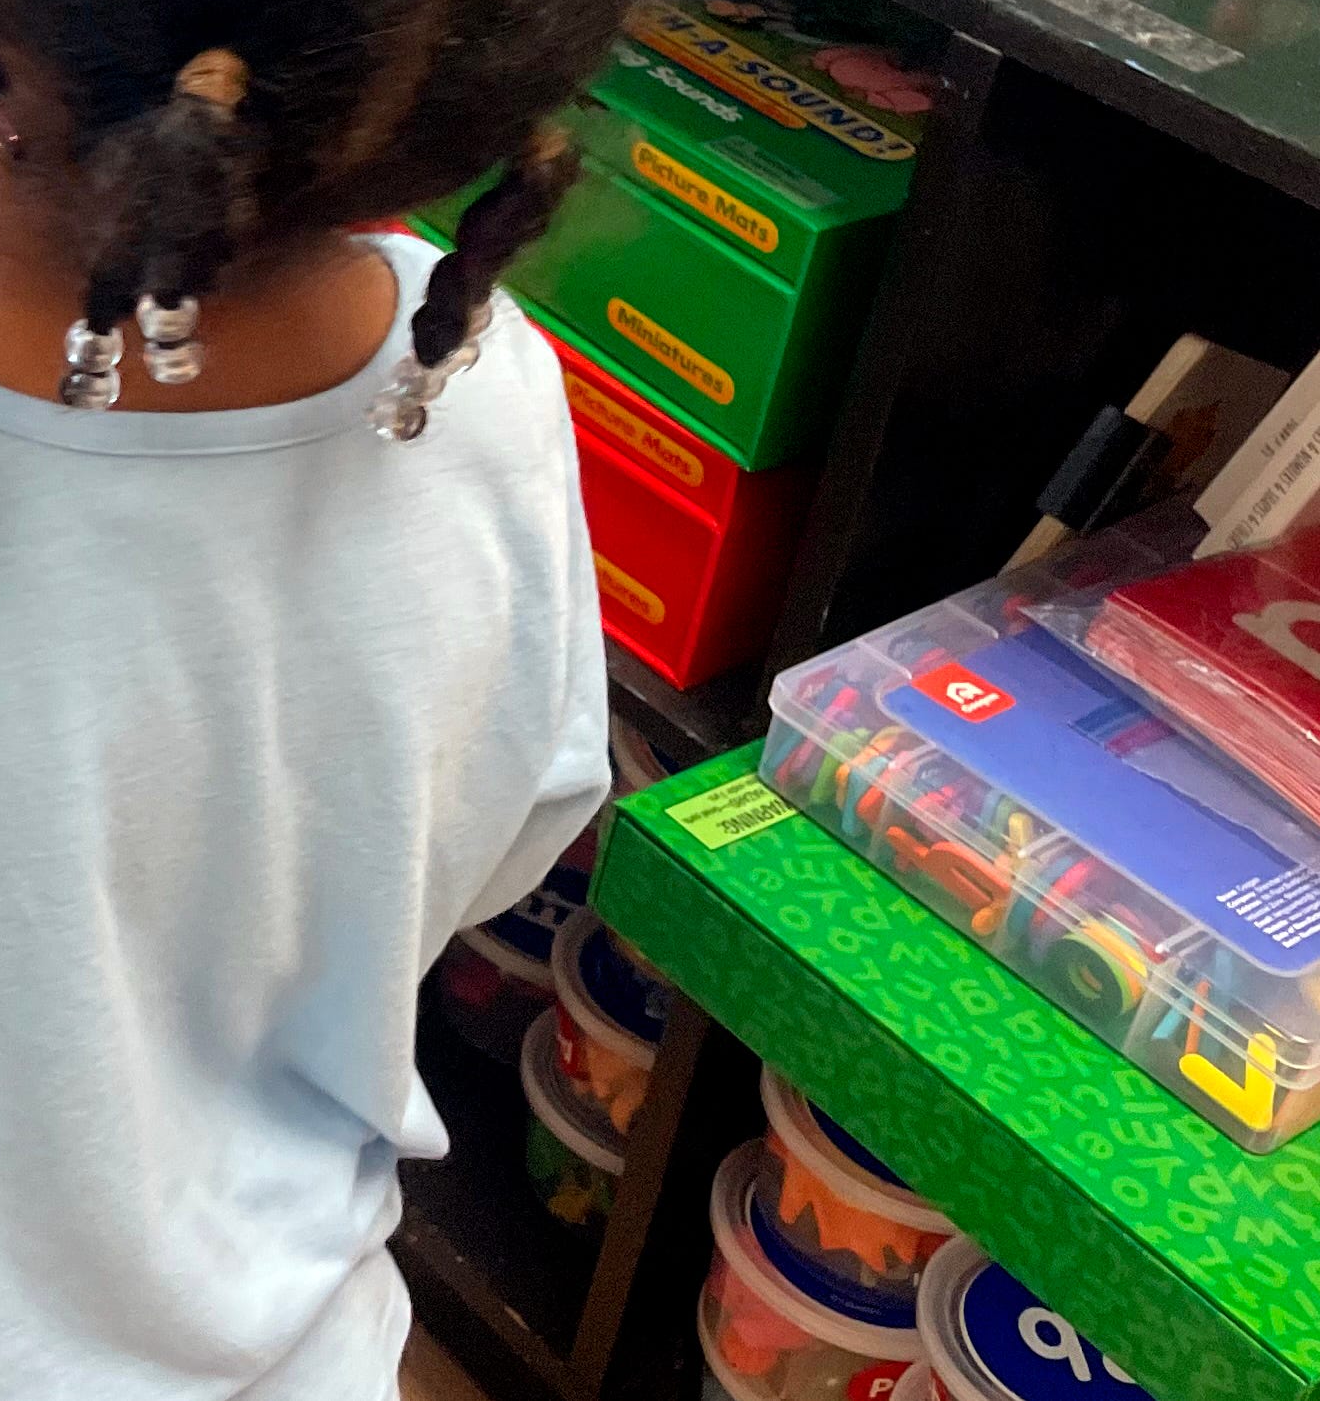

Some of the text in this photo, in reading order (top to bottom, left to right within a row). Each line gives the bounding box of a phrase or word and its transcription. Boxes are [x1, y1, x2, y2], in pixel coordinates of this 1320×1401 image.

[659, 11, 910, 155] H-A-SOUND!
[637, 147, 709, 204] Picture
[714, 195, 768, 243] Mats
[617, 307, 724, 395] Miniatures
[571, 381, 692, 477] Picture Mats
